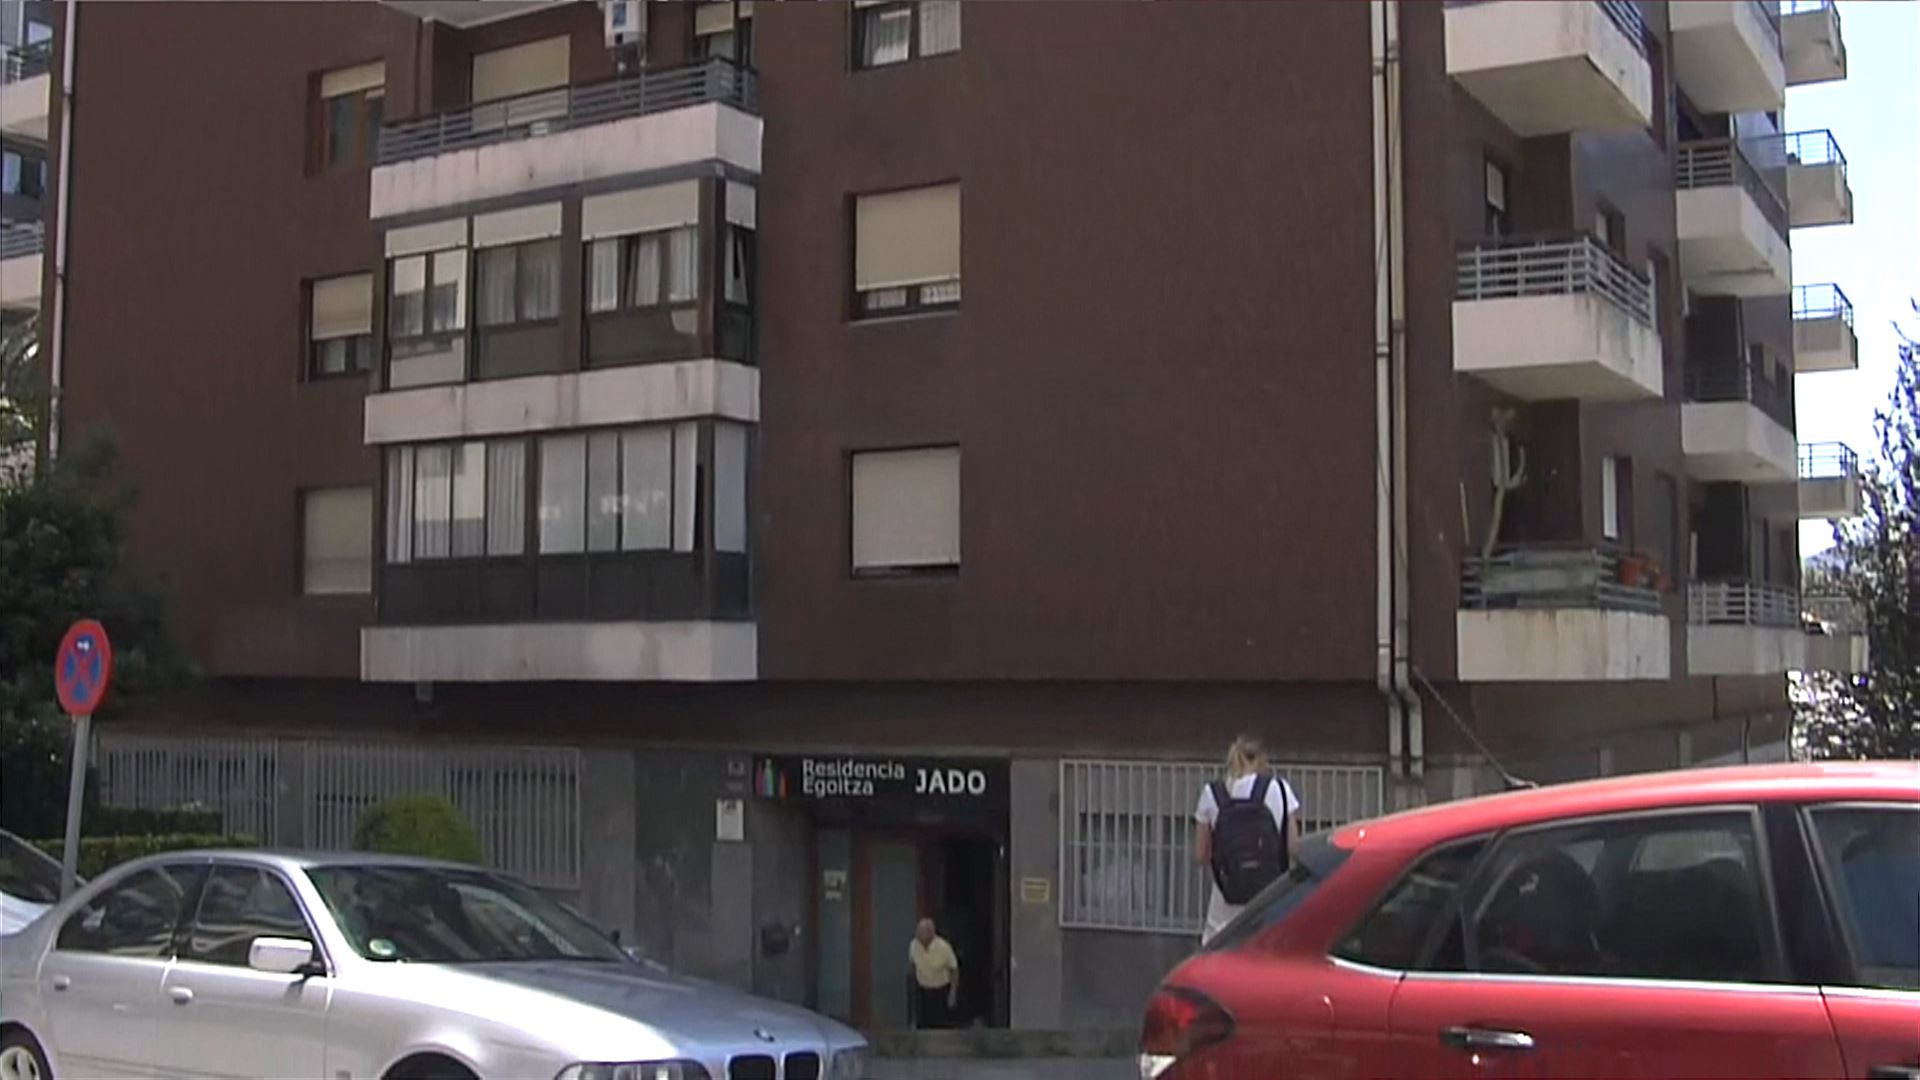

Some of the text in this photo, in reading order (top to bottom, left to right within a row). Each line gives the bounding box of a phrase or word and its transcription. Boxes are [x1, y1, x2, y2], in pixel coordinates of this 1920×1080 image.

[802, 759, 905, 780] Residencia
[802, 778, 874, 798] Egoitza
[915, 769, 986, 795] JADO
